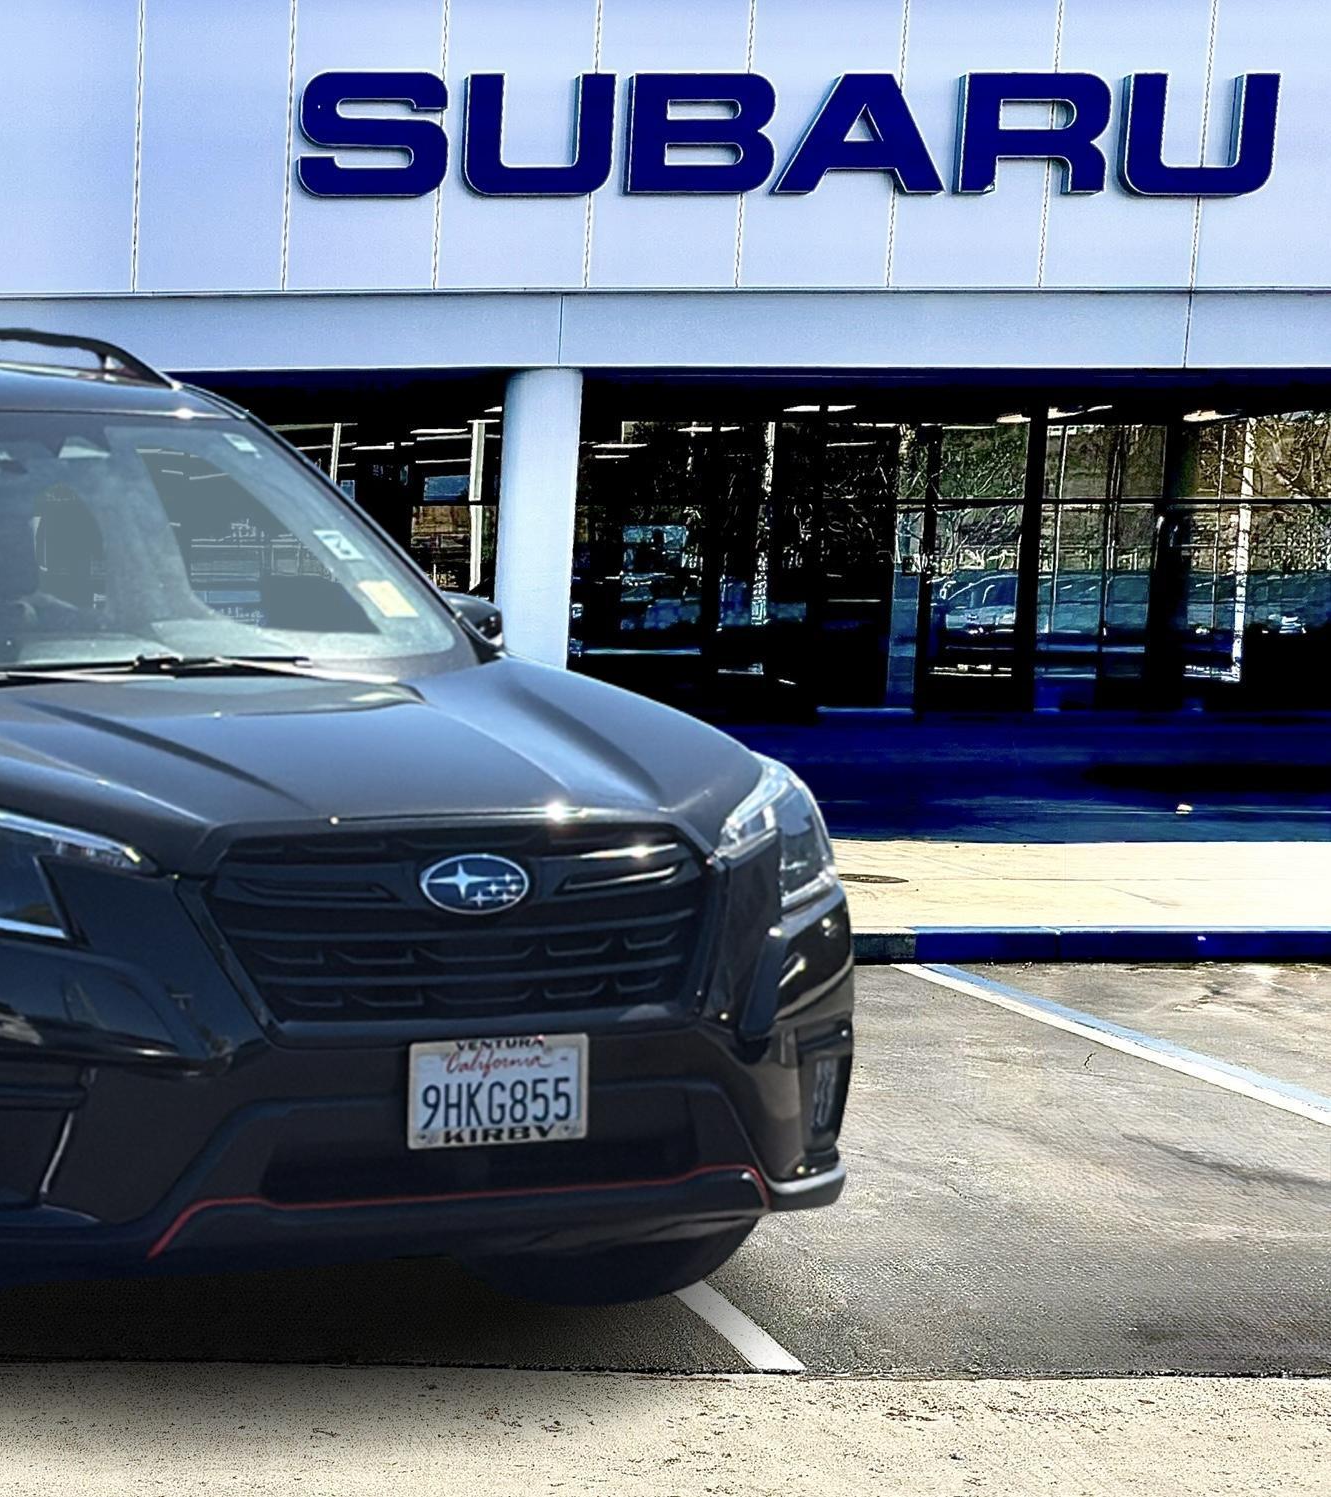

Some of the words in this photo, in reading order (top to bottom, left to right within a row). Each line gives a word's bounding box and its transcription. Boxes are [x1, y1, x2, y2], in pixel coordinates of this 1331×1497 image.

[297, 70, 1281, 197] SUBARU
[455, 1037, 545, 1050] VENTURA
[445, 1049, 552, 1077] California
[421, 1077, 572, 1130] 9HKG855
[444, 1123, 555, 1144] KIRBY
